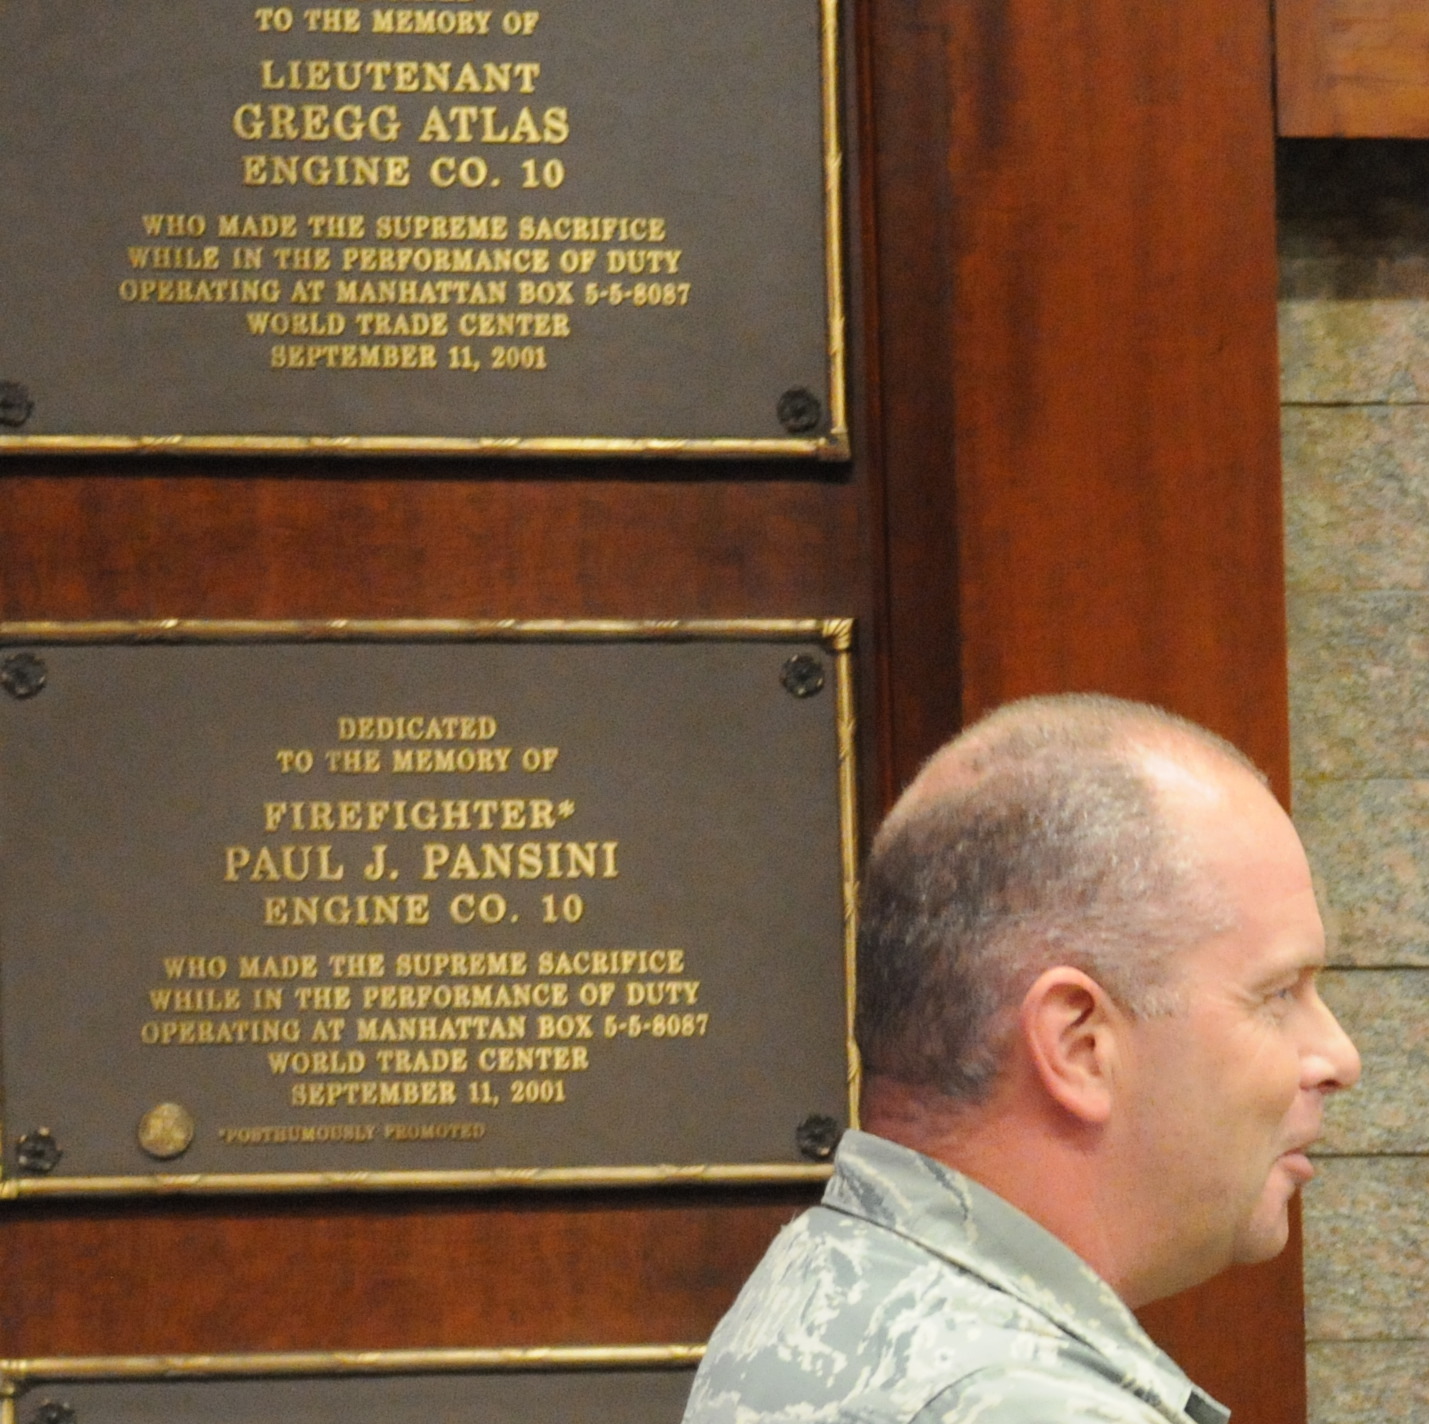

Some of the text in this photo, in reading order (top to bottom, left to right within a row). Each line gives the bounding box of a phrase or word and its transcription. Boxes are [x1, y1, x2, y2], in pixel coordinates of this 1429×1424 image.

[254, 6, 540, 35] TO THE MEMORY OF
[261, 59, 541, 93] LIEUTENANT
[233, 103, 570, 144] GREGG ATLAS
[244, 154, 565, 189] ENGINE CO. 10
[142, 214, 666, 242] WHO MADE THE SUPREME SACRIFICE
[129, 245, 682, 274] WHILE IN THE PERFORMANCE OF DUTY
[119, 279, 691, 306] OPERATING AT MANHATTAN BOX 5-5-8087
[247, 312, 571, 337] WORLD TRADE CENTER
[271, 344, 547, 372] SEPTEMBER 11, 2001
[338, 715, 497, 740] DEDICATED
[276, 746, 559, 773] TO THE MEMORY OF
[225, 840, 619, 881] PAUL J. PANSINI
[265, 892, 584, 925] ENGINE CO. 10
[164, 948, 685, 978] WHO MADE THE SUPREME SACRIFICE
[150, 980, 700, 1010] WHILE IN THE PERFORMANCE OF DUTY
[141, 1012, 709, 1044] OPERATING AT MANHATTAN BOX 5-5-8087
[268, 1045, 589, 1073] WORLD TRADE CENTER
[291, 1079, 566, 1106] SEPTEMBER 11, 2001
